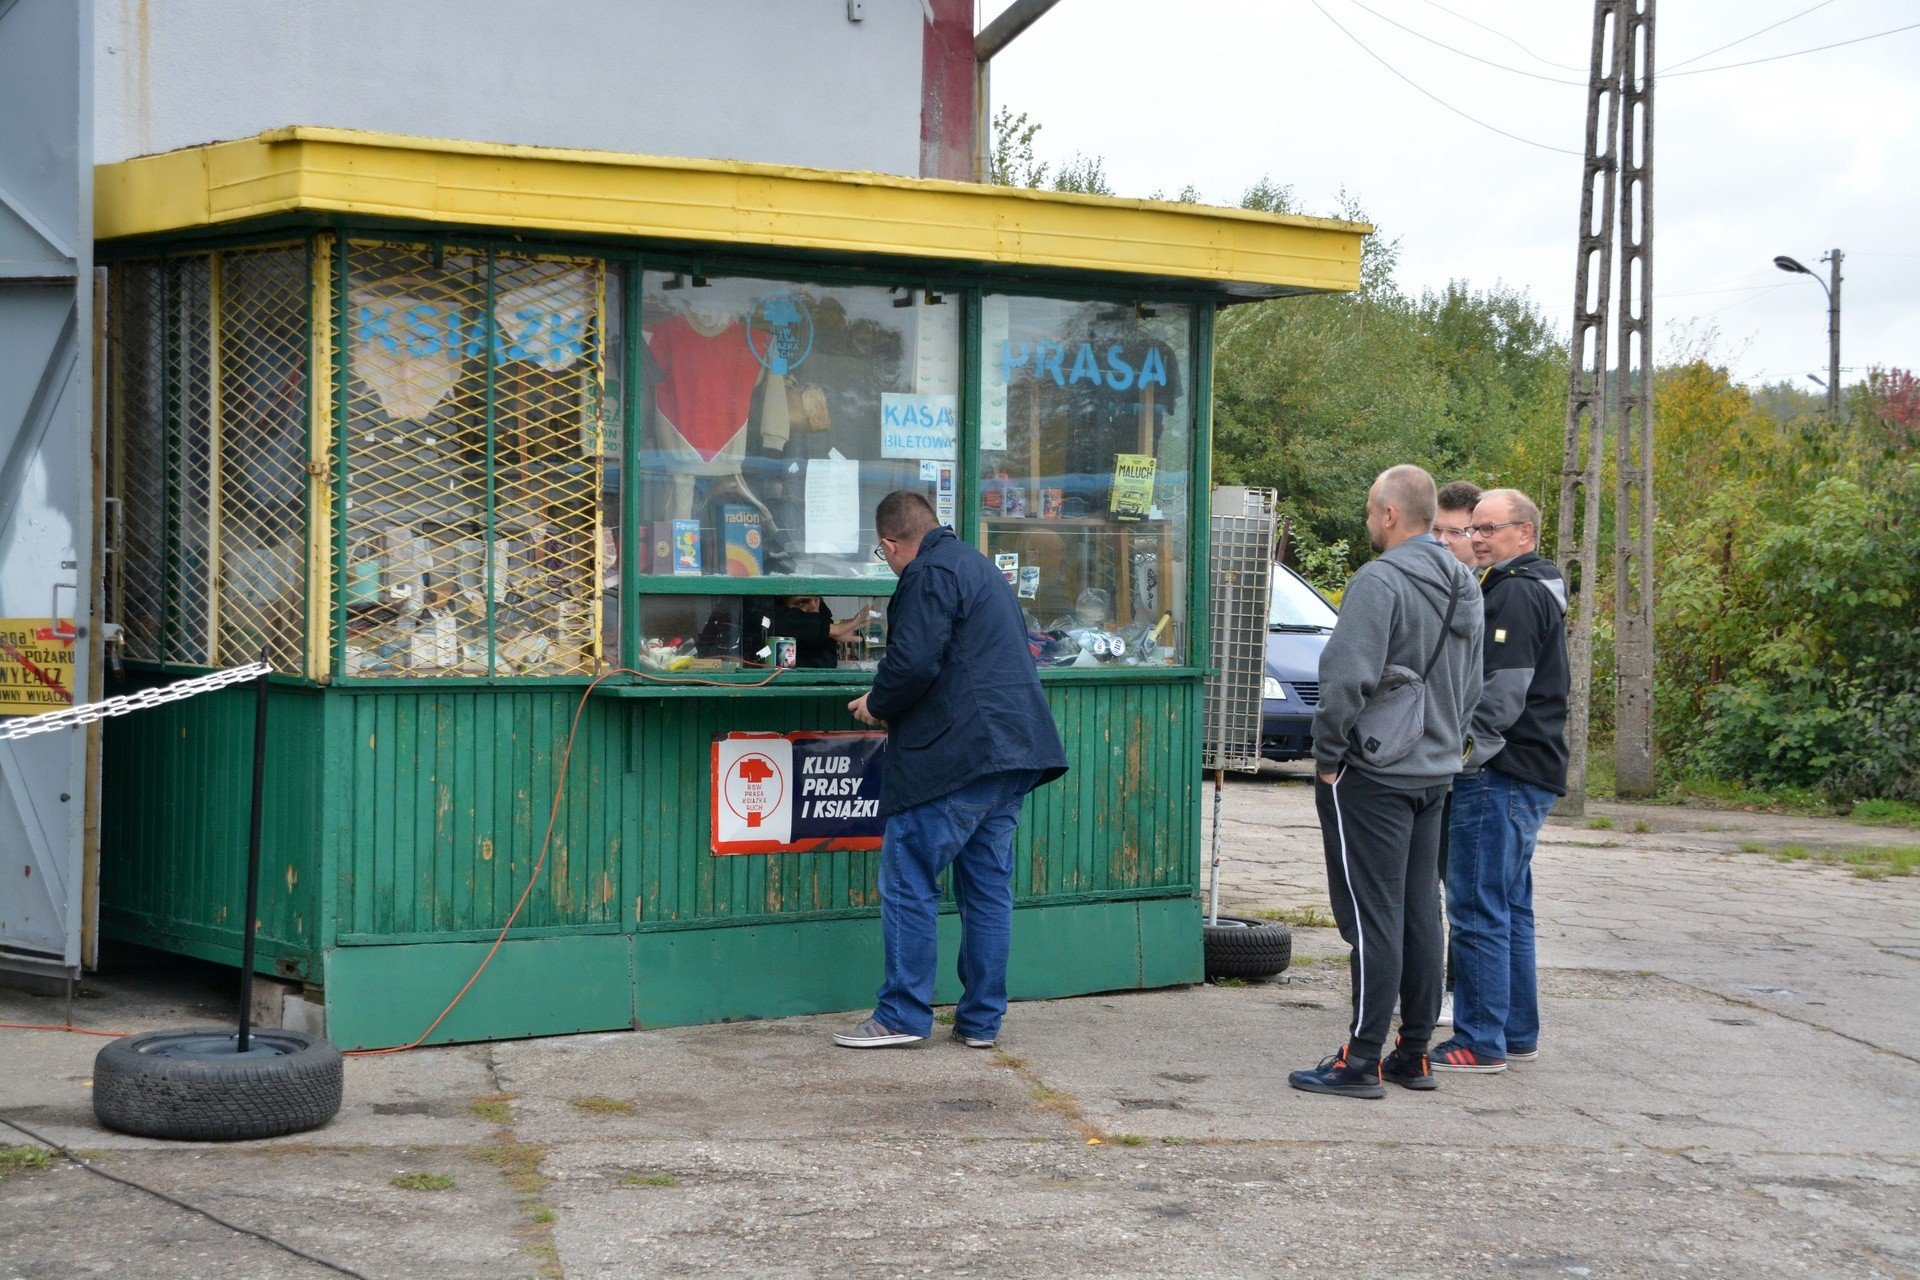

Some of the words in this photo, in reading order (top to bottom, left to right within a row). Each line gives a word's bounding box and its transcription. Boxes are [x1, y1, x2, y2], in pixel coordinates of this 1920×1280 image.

[1002, 340, 1167, 391] PRASA
[884, 404, 954, 428] KASA
[884, 433, 953, 448] BILETOWA
[1118, 465, 1153, 479] MALUCH
[725, 511, 760, 523] radion
[25, 648, 75, 664] POŻARU
[802, 756, 851, 774] KLUB
[801, 777, 863, 796] PRASY
[801, 801, 809, 819] I
[812, 796, 880, 820] KSIĄŻKI
